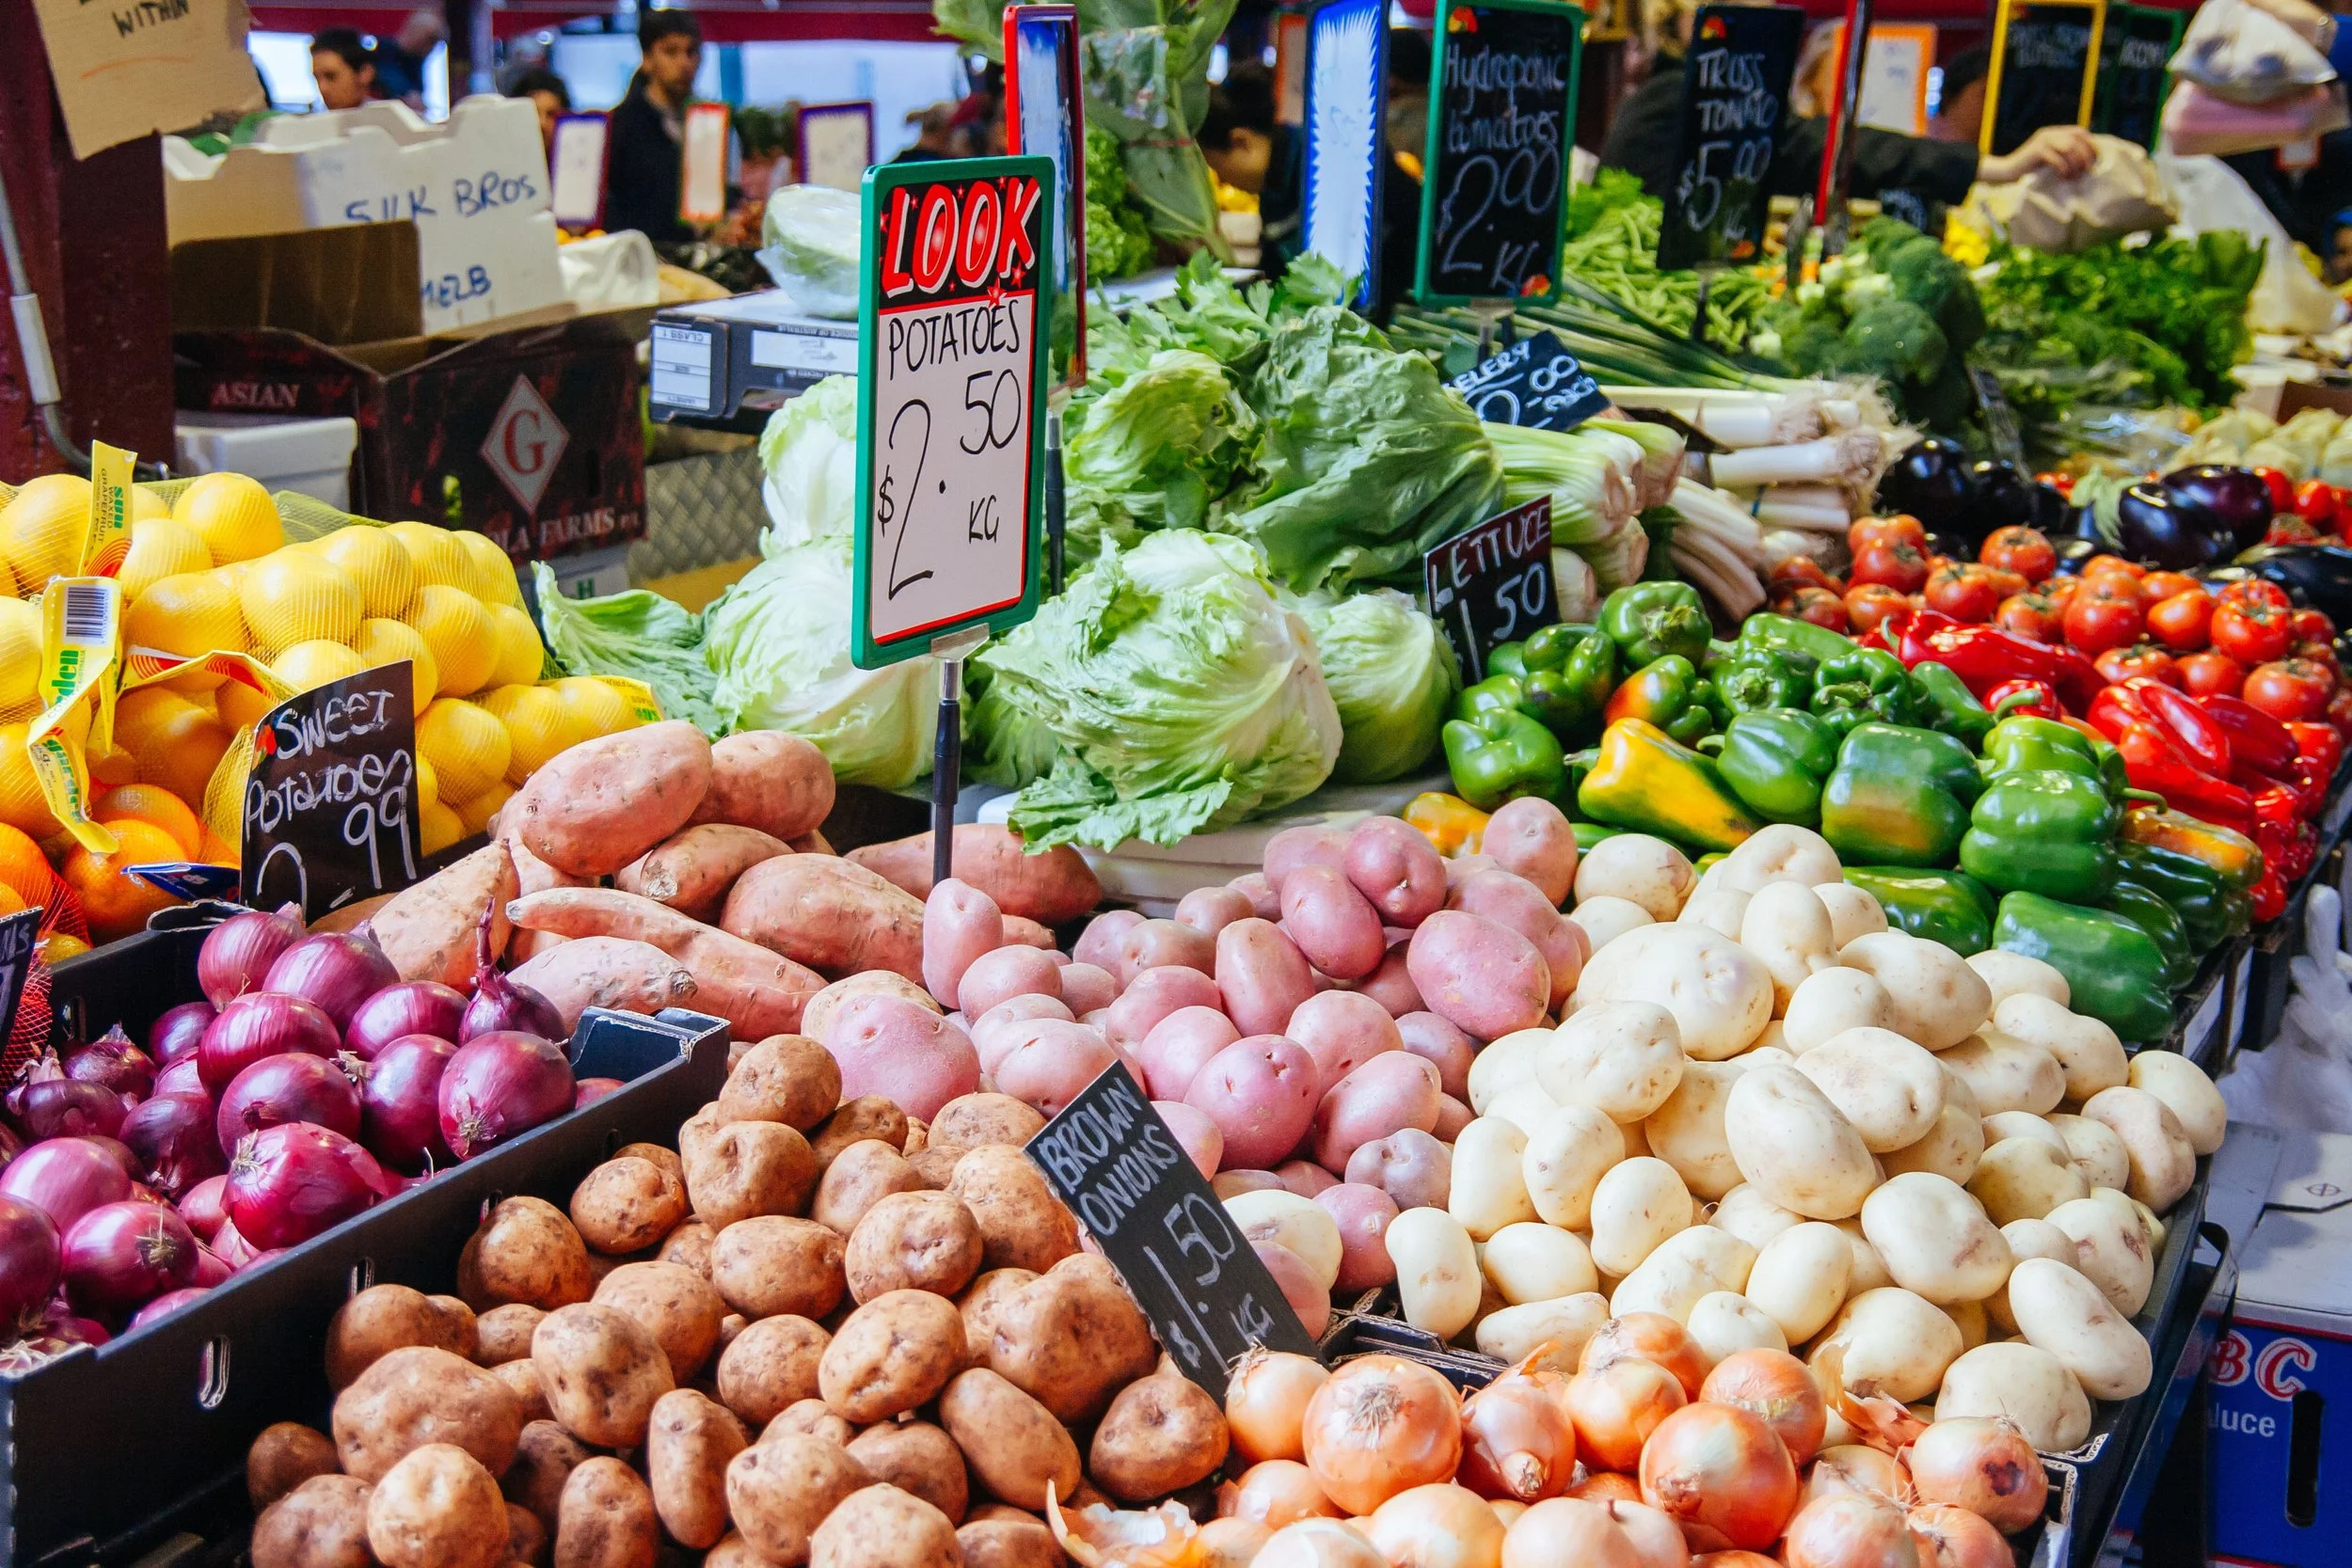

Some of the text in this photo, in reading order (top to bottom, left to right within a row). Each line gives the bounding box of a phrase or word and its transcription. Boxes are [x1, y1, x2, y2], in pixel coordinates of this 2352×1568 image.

[453, 171, 537, 217] BROS
[882, 176, 1041, 299] LOOK
[672, 331, 706, 342] CLASS
[888, 299, 1021, 381] POTATOES
[1442, 340, 1531, 393] ELERY
[210, 382, 299, 409] ASIAN
[503, 408, 547, 476] G
[97, 467, 108, 545] GRAPEFRUIT
[539, 507, 615, 545] FARMS
[968, 494, 1000, 545] KG
[1430, 503, 1551, 613] LETTUCE
[275, 689, 394, 760] SWEET
[1037, 1077, 1142, 1196] BROWN
[1077, 1124, 1179, 1238] ONIONS
[2213, 1402, 2277, 1438] uce
